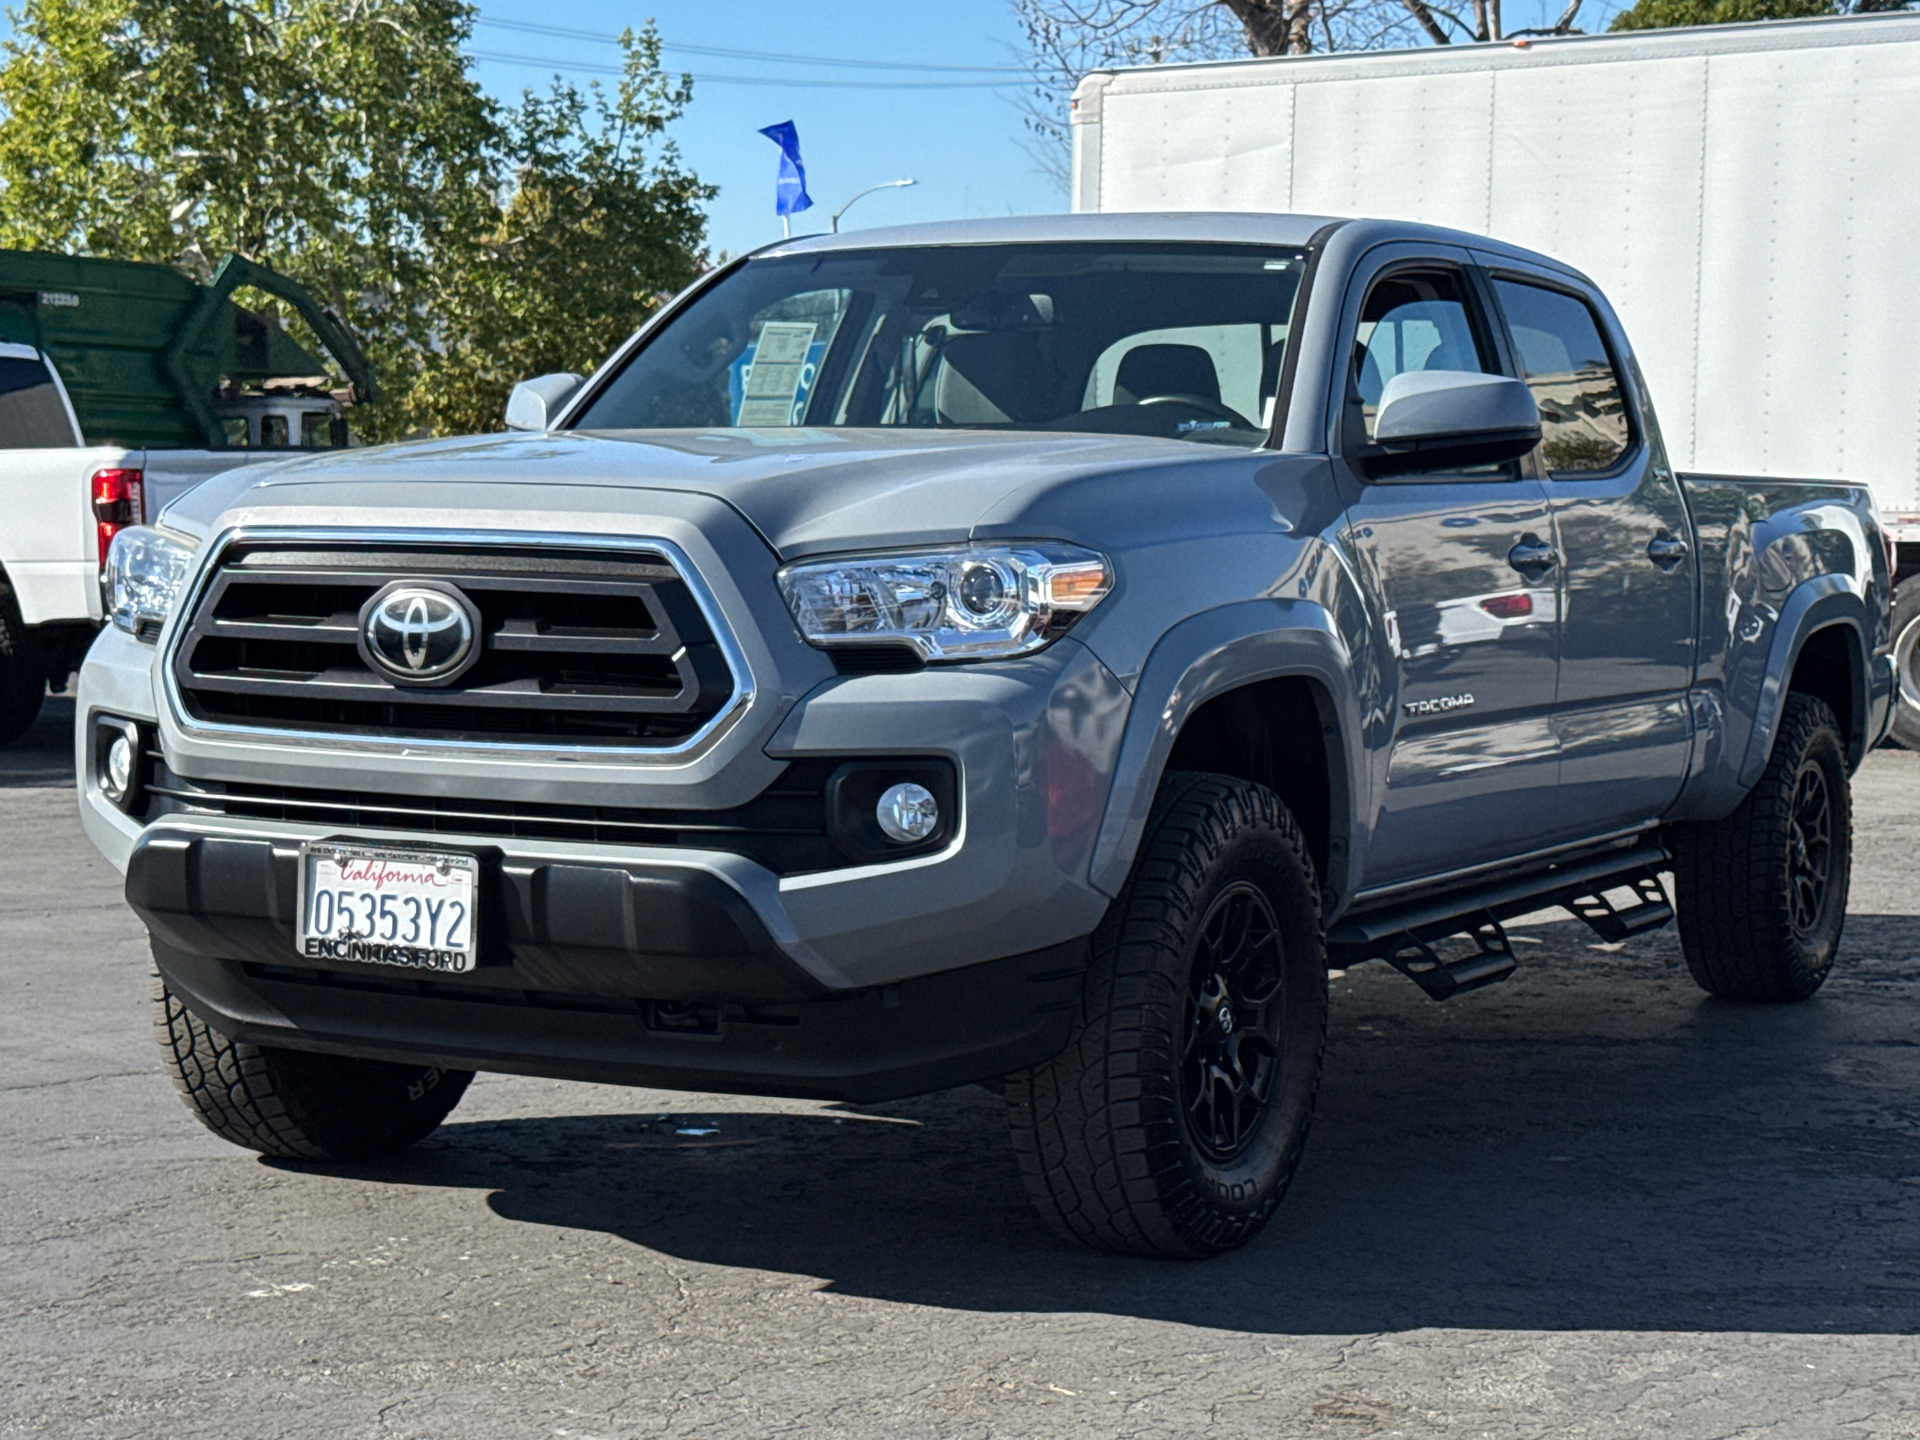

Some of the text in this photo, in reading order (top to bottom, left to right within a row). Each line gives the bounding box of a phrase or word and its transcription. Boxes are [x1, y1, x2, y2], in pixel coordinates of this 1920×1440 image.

[1404, 692, 1475, 716] TACOMA
[340, 858, 447, 890] California
[314, 888, 465, 948] 05353Y2
[305, 938, 467, 972] ENCINITAS FORD
[406, 1066, 447, 1102] ER
